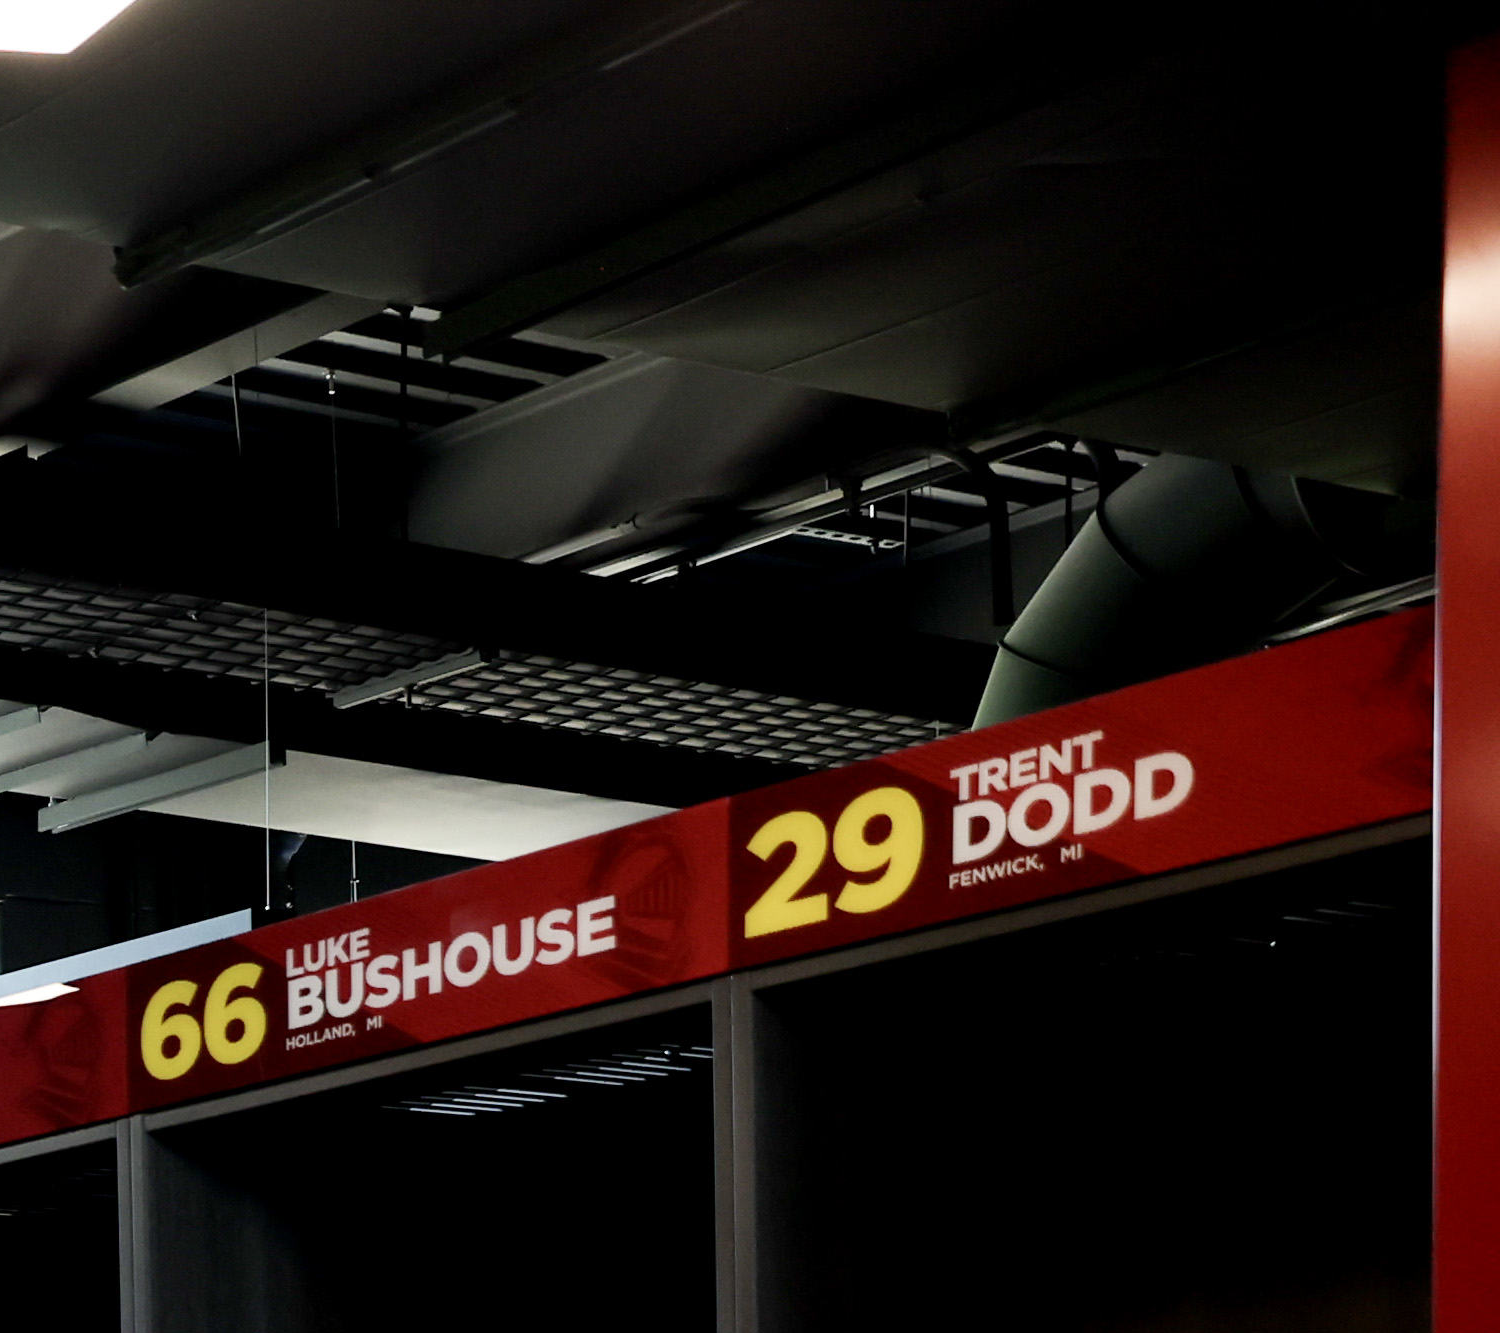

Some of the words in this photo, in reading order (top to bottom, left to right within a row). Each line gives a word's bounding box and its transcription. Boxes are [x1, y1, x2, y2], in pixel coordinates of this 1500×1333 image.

[950, 730, 1104, 802] TRENT
[952, 751, 1195, 866] DODD
[745, 786, 924, 939] 29
[949, 856, 1045, 889] FENWICK,
[1060, 842, 1083, 865] MI
[285, 927, 371, 977] LUKE
[287, 895, 617, 1030] BUSHOUSE
[141, 962, 266, 1081] 66
[285, 1022, 356, 1051] HOLLAND,
[367, 1015, 383, 1031] MI
